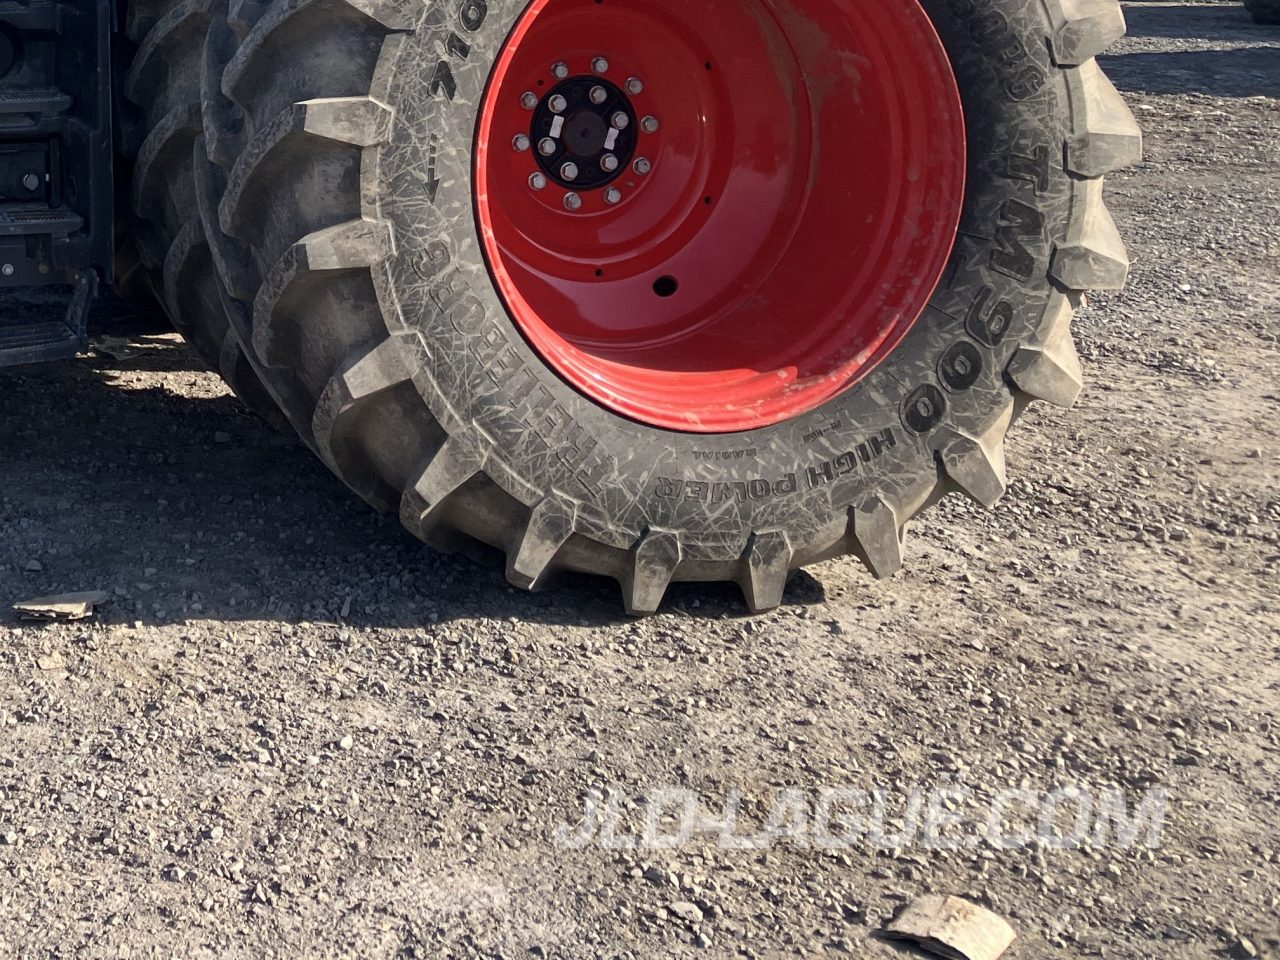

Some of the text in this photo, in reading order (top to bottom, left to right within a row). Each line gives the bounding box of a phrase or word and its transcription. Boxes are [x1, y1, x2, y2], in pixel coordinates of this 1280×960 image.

[410, 240, 615, 498] TRELLEBORG
[654, 472, 797, 504] POWER
[806, 427, 898, 490] HIGH
